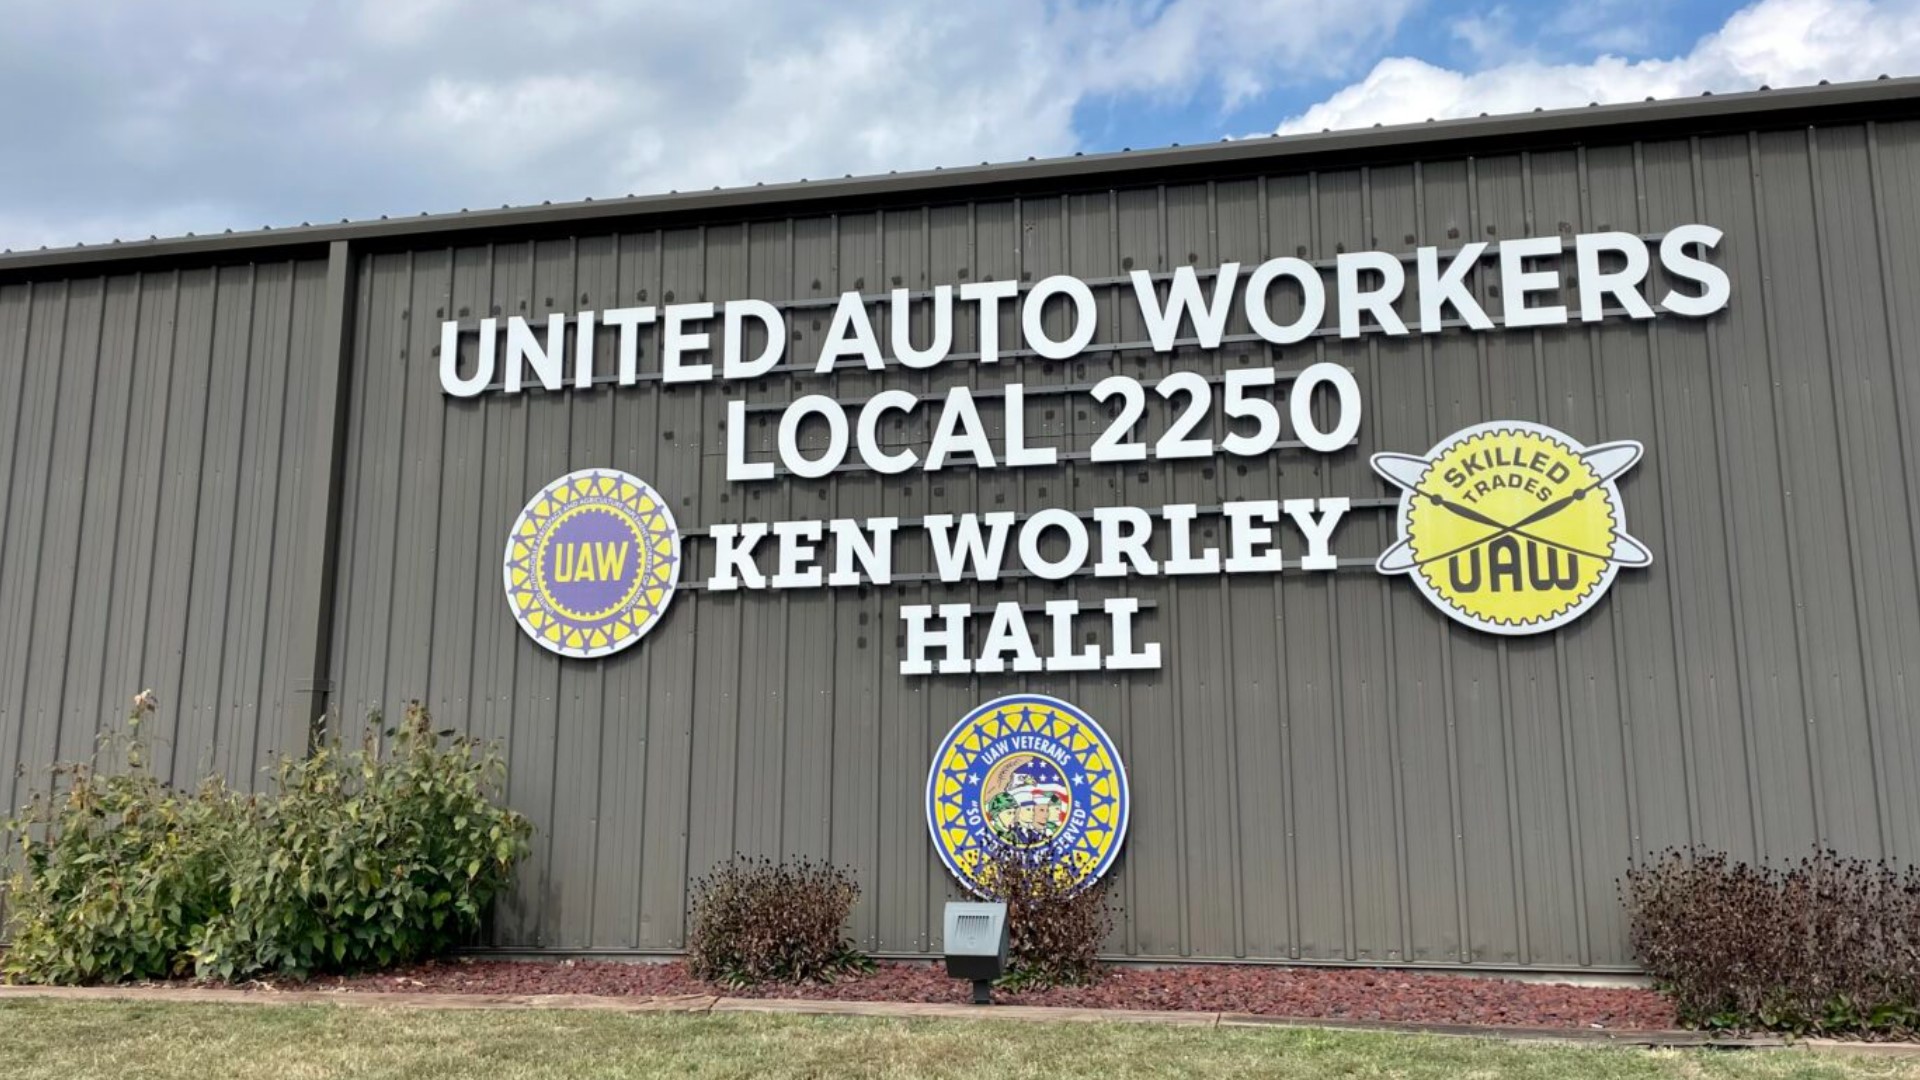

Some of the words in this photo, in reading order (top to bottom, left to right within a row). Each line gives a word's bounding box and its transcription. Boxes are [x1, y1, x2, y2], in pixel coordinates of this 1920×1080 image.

[439, 299, 785, 397] UNITED
[815, 274, 1097, 373] AUTO
[1129, 224, 1731, 352] WORKERS
[726, 383, 1057, 481] LOCAL
[1090, 362, 1362, 462] 2250
[1444, 446, 1570, 489] SKILLED
[1463, 474, 1553, 504] TRADES
[554, 540, 629, 583] UAW
[707, 517, 898, 591] KEN
[923, 497, 1350, 582] WORLEY
[1449, 535, 1580, 593] UAW
[900, 598, 1161, 676] HALL
[982, 739, 1009, 766] UAW
[1012, 735, 1071, 766] VETERANS
